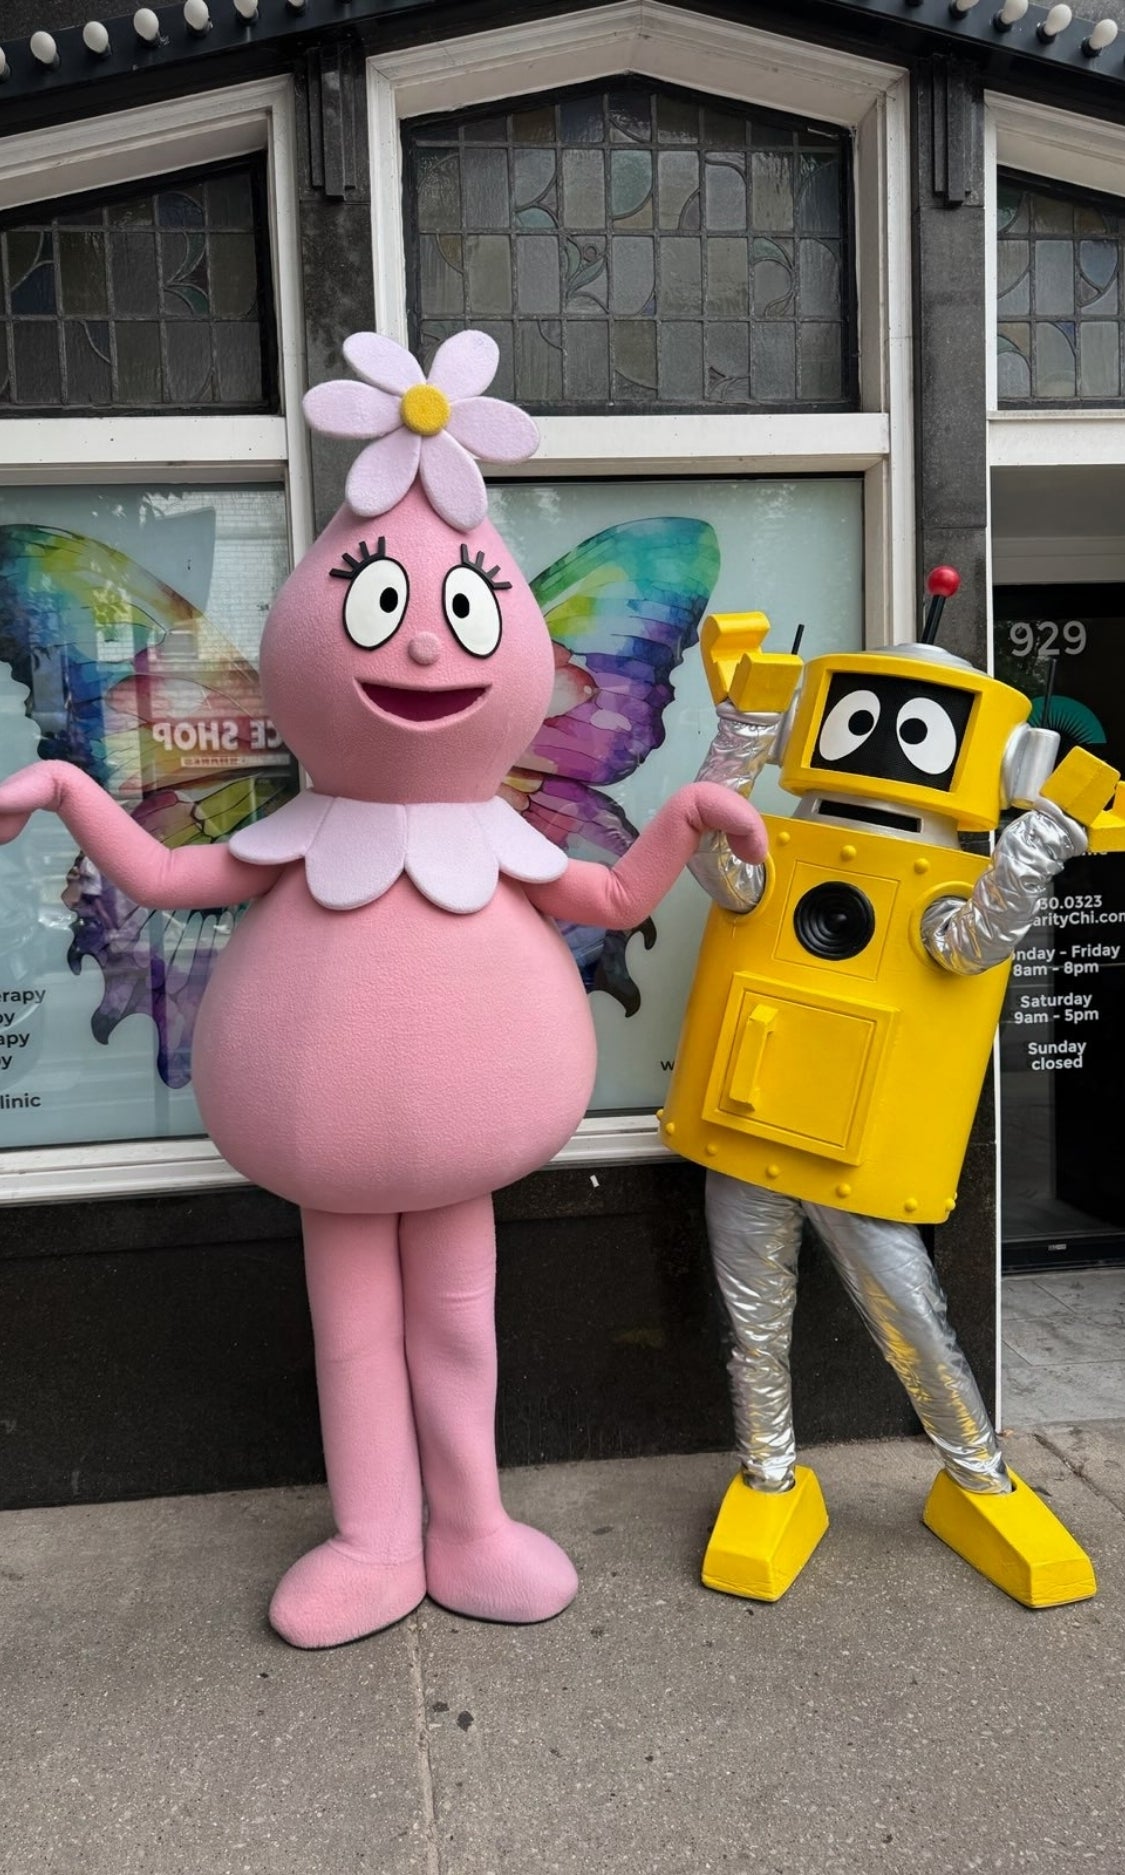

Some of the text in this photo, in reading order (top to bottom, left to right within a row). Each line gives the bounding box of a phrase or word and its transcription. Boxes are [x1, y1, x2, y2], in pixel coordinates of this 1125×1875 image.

[1010, 621, 1087, 657] 929
[1071, 943, 1121, 959] Friday
[1013, 964, 1048, 977] 8am
[1064, 961, 1099, 977] 8pm
[1020, 992, 1093, 1009] Saturday
[1014, 1011, 1049, 1024] 9am
[1064, 1009, 1099, 1024] 5pm
[1028, 1039, 1087, 1056] Sunday
[1031, 1055, 1083, 1071] closed
